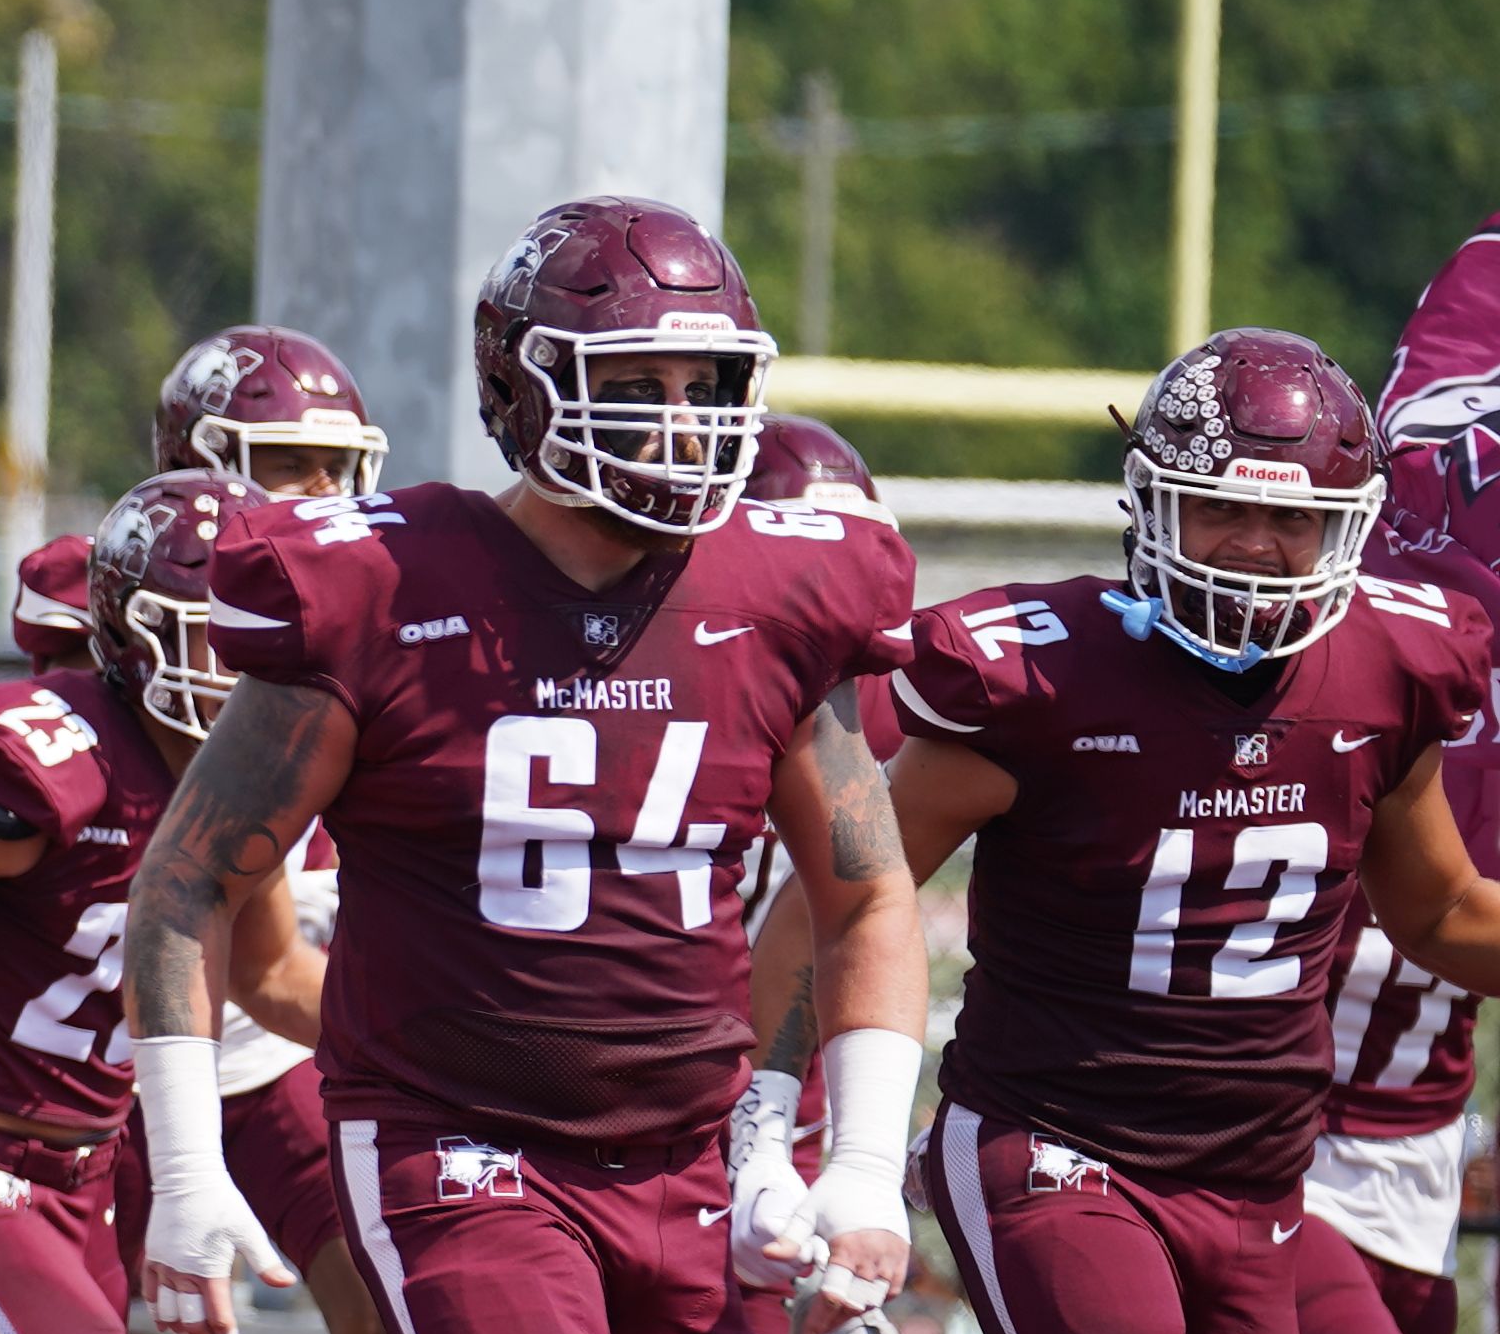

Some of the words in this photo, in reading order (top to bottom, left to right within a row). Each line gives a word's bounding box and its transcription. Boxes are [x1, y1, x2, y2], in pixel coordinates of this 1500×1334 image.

[1235, 464, 1301, 484] Riddell
[1355, 574, 1452, 629] 12
[399, 615, 471, 645] OUA
[959, 599, 1070, 662] 12
[536, 677, 674, 711] McMASTER
[1071, 733, 1142, 754] OUA
[477, 714, 728, 932] 64
[1178, 782, 1306, 819] McMASTER
[1127, 821, 1329, 999] 12
[9, 902, 133, 1065] 2
